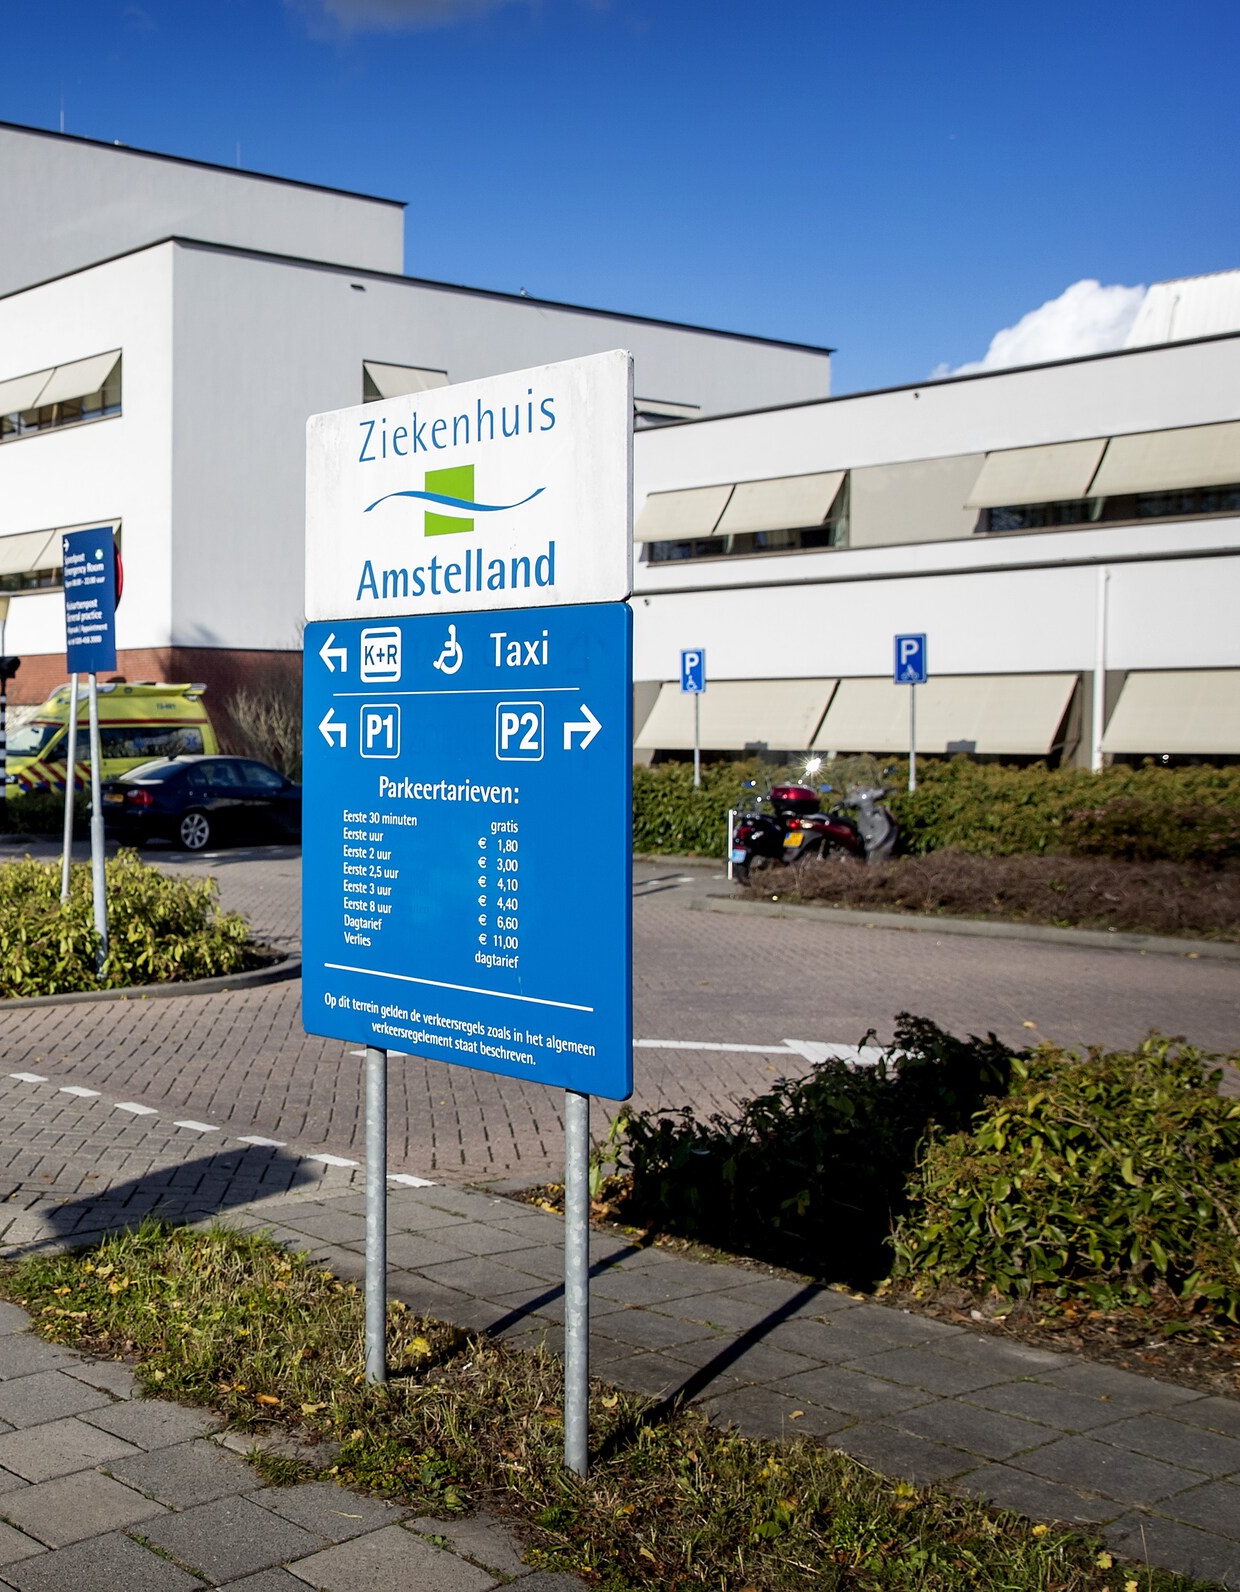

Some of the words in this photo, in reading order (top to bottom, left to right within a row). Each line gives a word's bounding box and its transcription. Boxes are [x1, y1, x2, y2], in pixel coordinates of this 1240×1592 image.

[359, 388, 556, 462] Ziekenhuis
[86, 562, 105, 573] Room
[356, 540, 556, 601] Amstelland
[364, 644, 398, 666] K+R
[490, 629, 549, 668] Taxi
[900, 639, 920, 665] P
[685, 653, 699, 675] P
[366, 713, 394, 748] P1
[501, 712, 539, 750] P2
[379, 775, 520, 804] Parkeertarieven:
[343, 809, 367, 823] Eerste
[369, 812, 380, 824] 30
[382, 812, 418, 826] minuten
[343, 827, 367, 841] Eerste
[369, 832, 384, 842] uur
[491, 819, 519, 835] gratis
[343, 844, 367, 859] Eerste
[369, 847, 375, 859] 2
[377, 850, 392, 860] uur
[478, 837, 487, 849] €
[497, 839, 519, 853] 1,80
[343, 862, 367, 876] Eerste
[369, 865, 382, 878] 2,5
[384, 869, 399, 879] uur
[478, 856, 487, 869] €
[497, 858, 519, 873] 3,00
[343, 879, 367, 894] Eerste
[369, 883, 375, 895] 3
[377, 886, 392, 896] uur
[478, 875, 487, 888] €
[497, 877, 519, 892] 4,10
[343, 897, 367, 911] Eerste
[369, 900, 376, 912] 8
[377, 903, 392, 914] uur
[478, 894, 487, 907] €
[497, 896, 519, 911] 4,40
[344, 914, 382, 931] Dagtarief
[478, 914, 487, 926] €
[497, 915, 519, 930] 6,60
[343, 931, 372, 947] Verlies
[478, 933, 488, 945] €
[493, 934, 519, 950] 11,00
[475, 950, 520, 969] dagtarief
[324, 992, 337, 1009] Op
[338, 995, 350, 1009] dit
[352, 998, 379, 1014] terrein
[380, 1004, 409, 1020] gelden
[410, 1009, 421, 1023] de
[423, 1013, 486, 1036] verkeersregels
[487, 1026, 512, 1041] zoals
[513, 1028, 523, 1043] in
[526, 1030, 544, 1047] het
[546, 1035, 596, 1057] algemeen
[371, 1022, 453, 1048] verkeersregelement
[454, 1038, 478, 1054] staat
[480, 1041, 537, 1066] beschreven.
